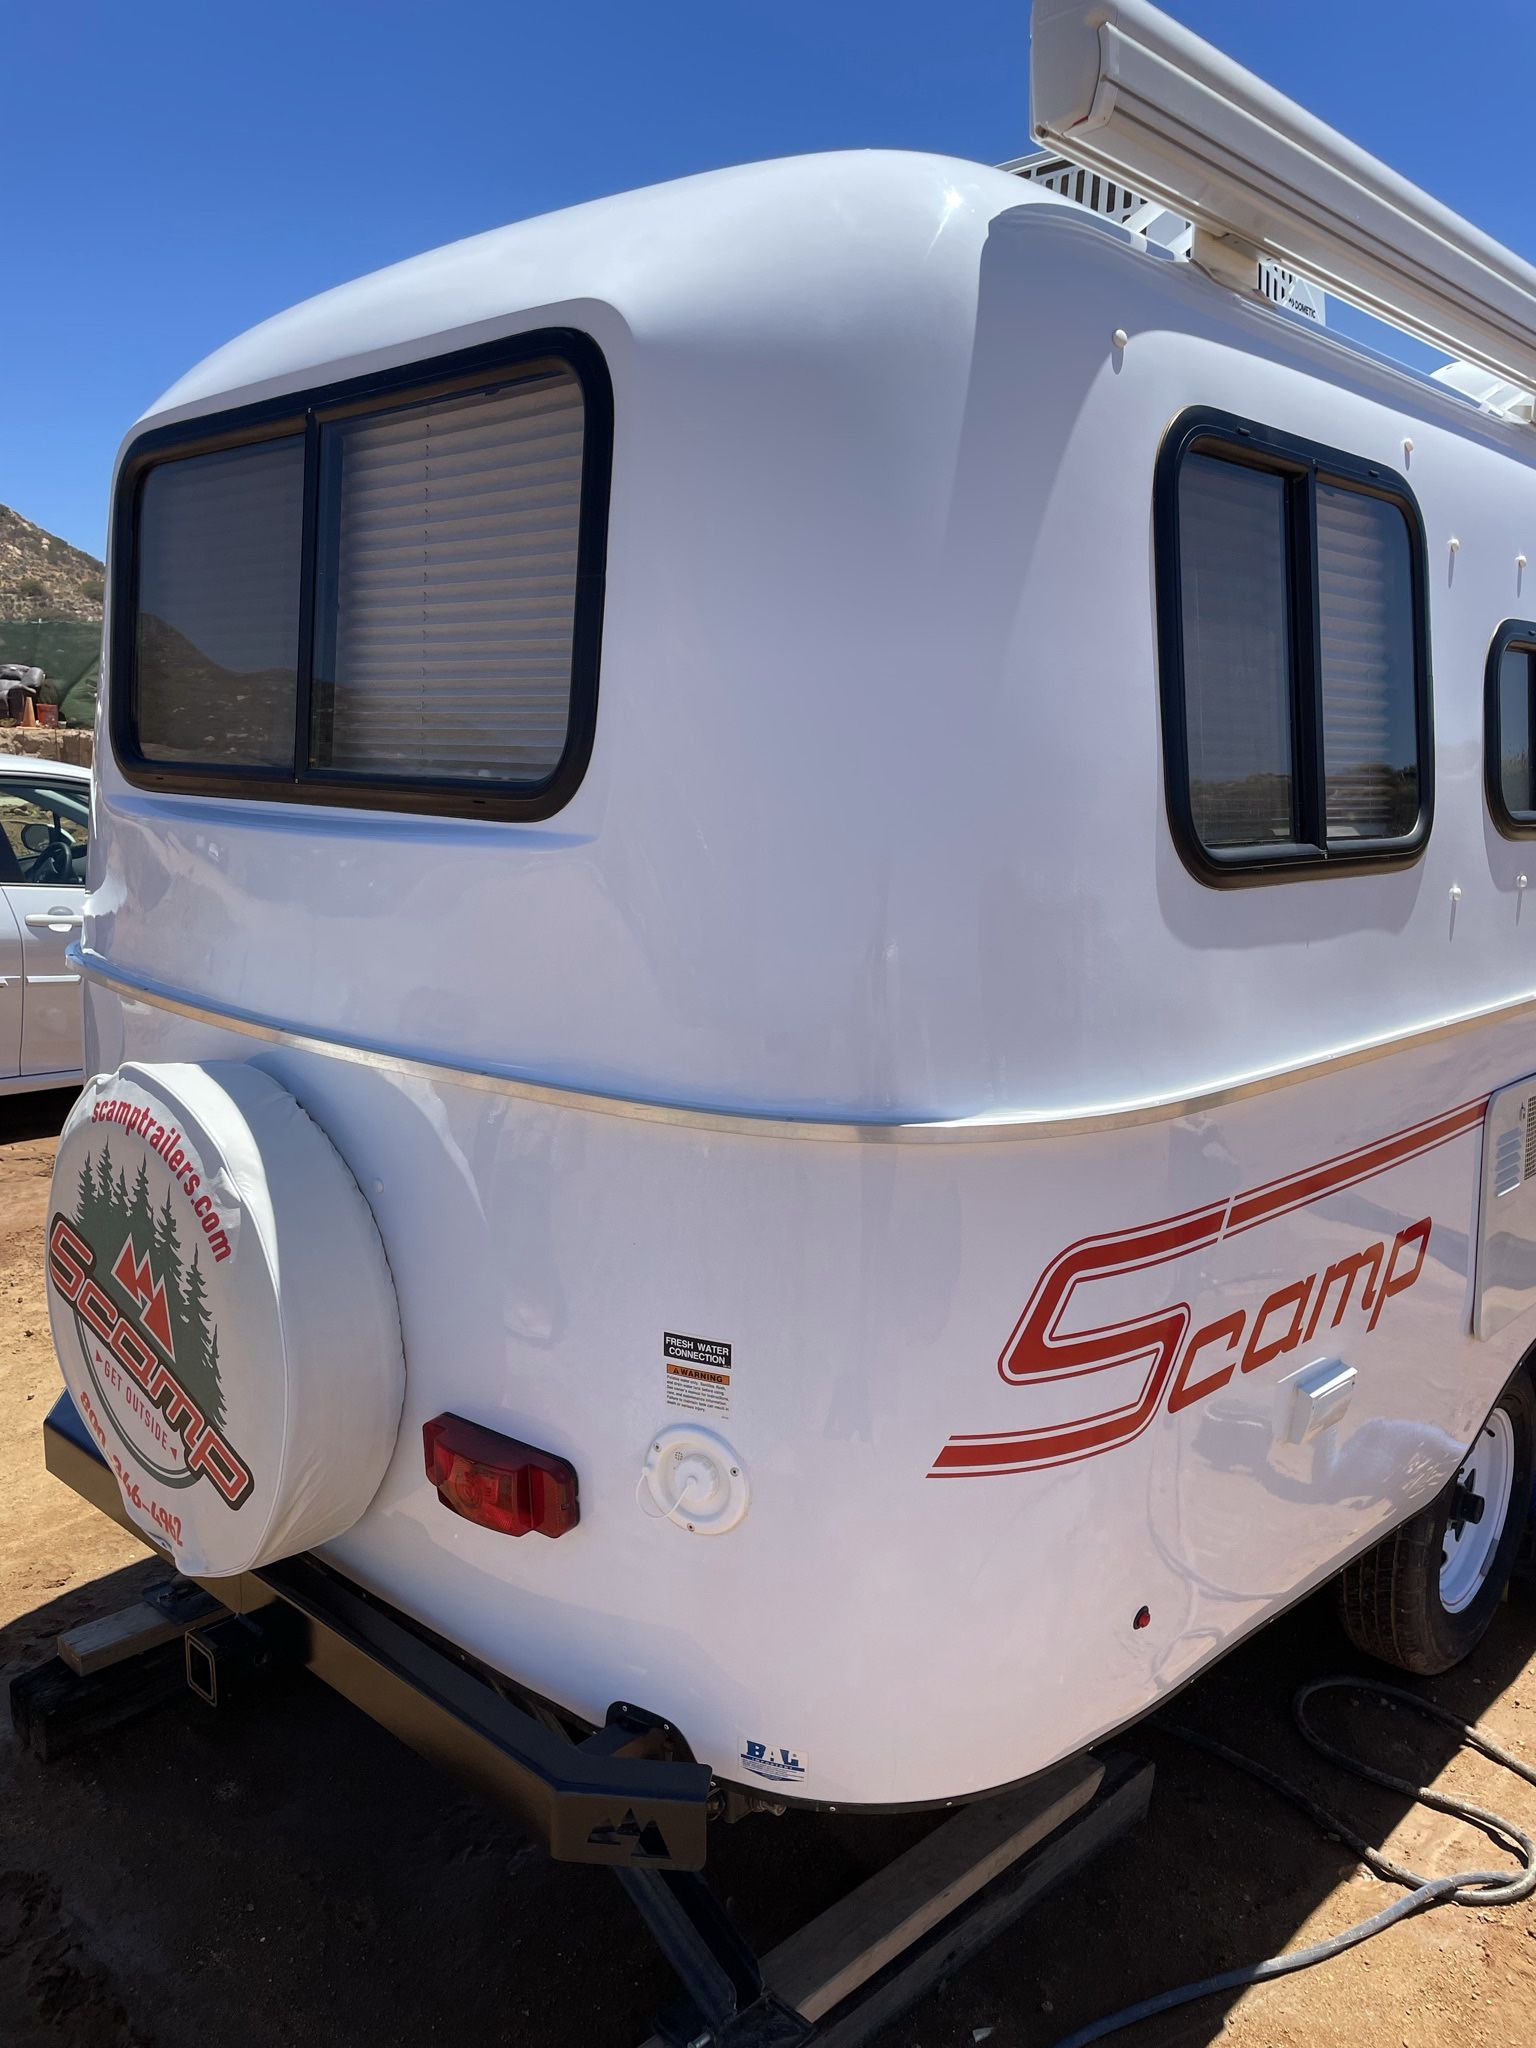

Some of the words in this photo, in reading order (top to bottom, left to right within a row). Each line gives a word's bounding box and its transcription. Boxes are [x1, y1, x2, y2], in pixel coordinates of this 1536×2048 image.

[1295, 300, 1316, 319] DOMETIC
[91, 1099, 232, 1263] scamptrailers.com
[665, 1336, 694, 1349] FRESH
[697, 1342, 729, 1356] WATER
[925, 1198, 1433, 1479] Scamp
[50, 1216, 250, 1504] Scamp
[669, 1346, 726, 1365] CONNECTION
[680, 1368, 723, 1383] WARNING
[104, 1362, 123, 1392] GET
[125, 1386, 167, 1450] OUTSIDE
[747, 1740, 799, 1767] BAL
